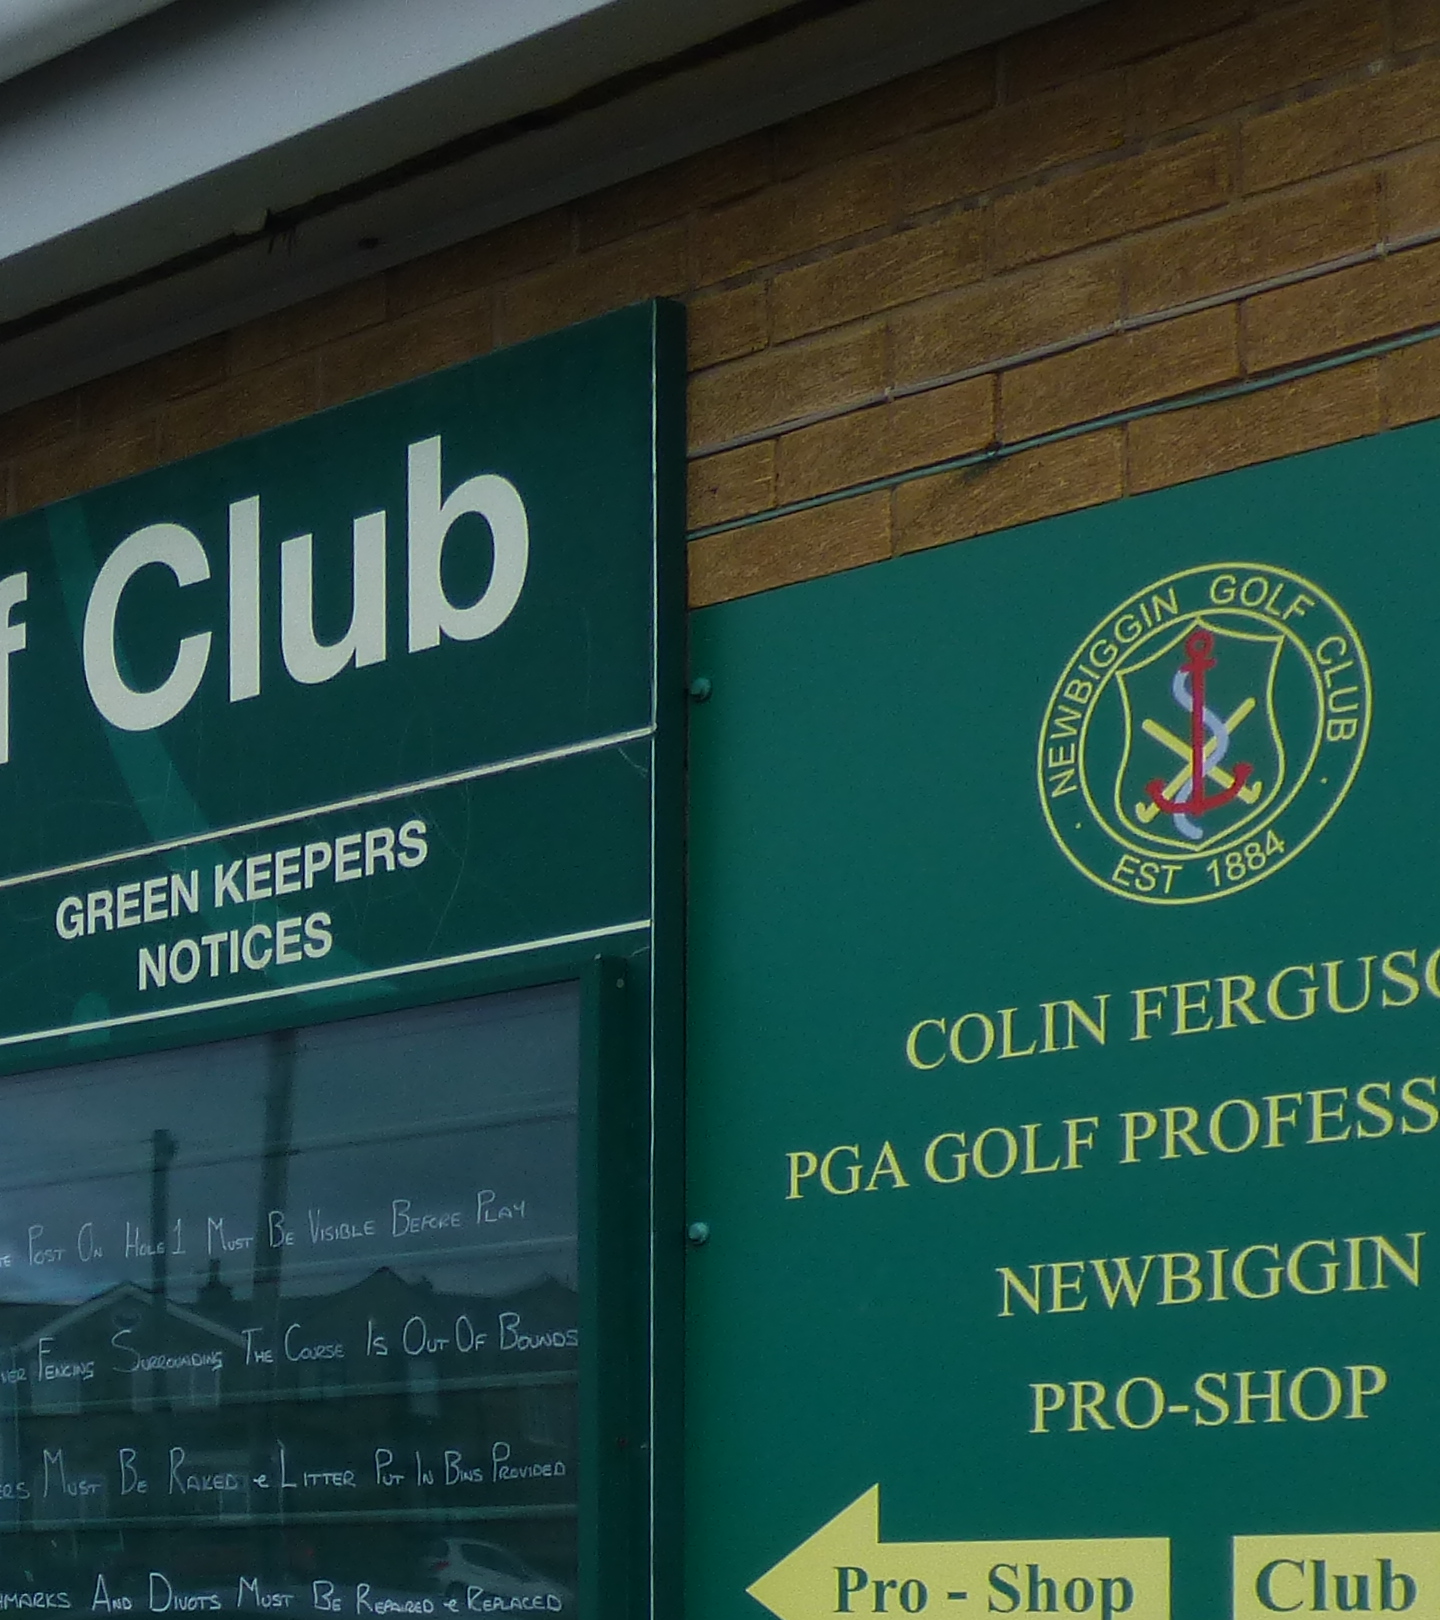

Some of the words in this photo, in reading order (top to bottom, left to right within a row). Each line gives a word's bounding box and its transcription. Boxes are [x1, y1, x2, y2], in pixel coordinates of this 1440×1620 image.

[84, 435, 530, 731] Club
[1048, 588, 1179, 798] NEWBIGGIN
[1210, 574, 1315, 620] GOLF
[1316, 635, 1358, 741] CLUB
[56, 870, 199, 941] GREEN
[215, 821, 428, 905] KEEPERS
[1112, 854, 1182, 893] EST
[1207, 829, 1285, 886] 1884
[138, 914, 331, 991] NOTICES
[906, 994, 1111, 1069] COLIN
[785, 1141, 909, 1200] PGA
[925, 1117, 1098, 1183] GOLF
[997, 1232, 1425, 1317] NEWBIGGIN
[1029, 1365, 1387, 1433] PRO-SHOP
[833, 1566, 928, 1613] Pro
[1255, 1558, 1418, 1611] Club
